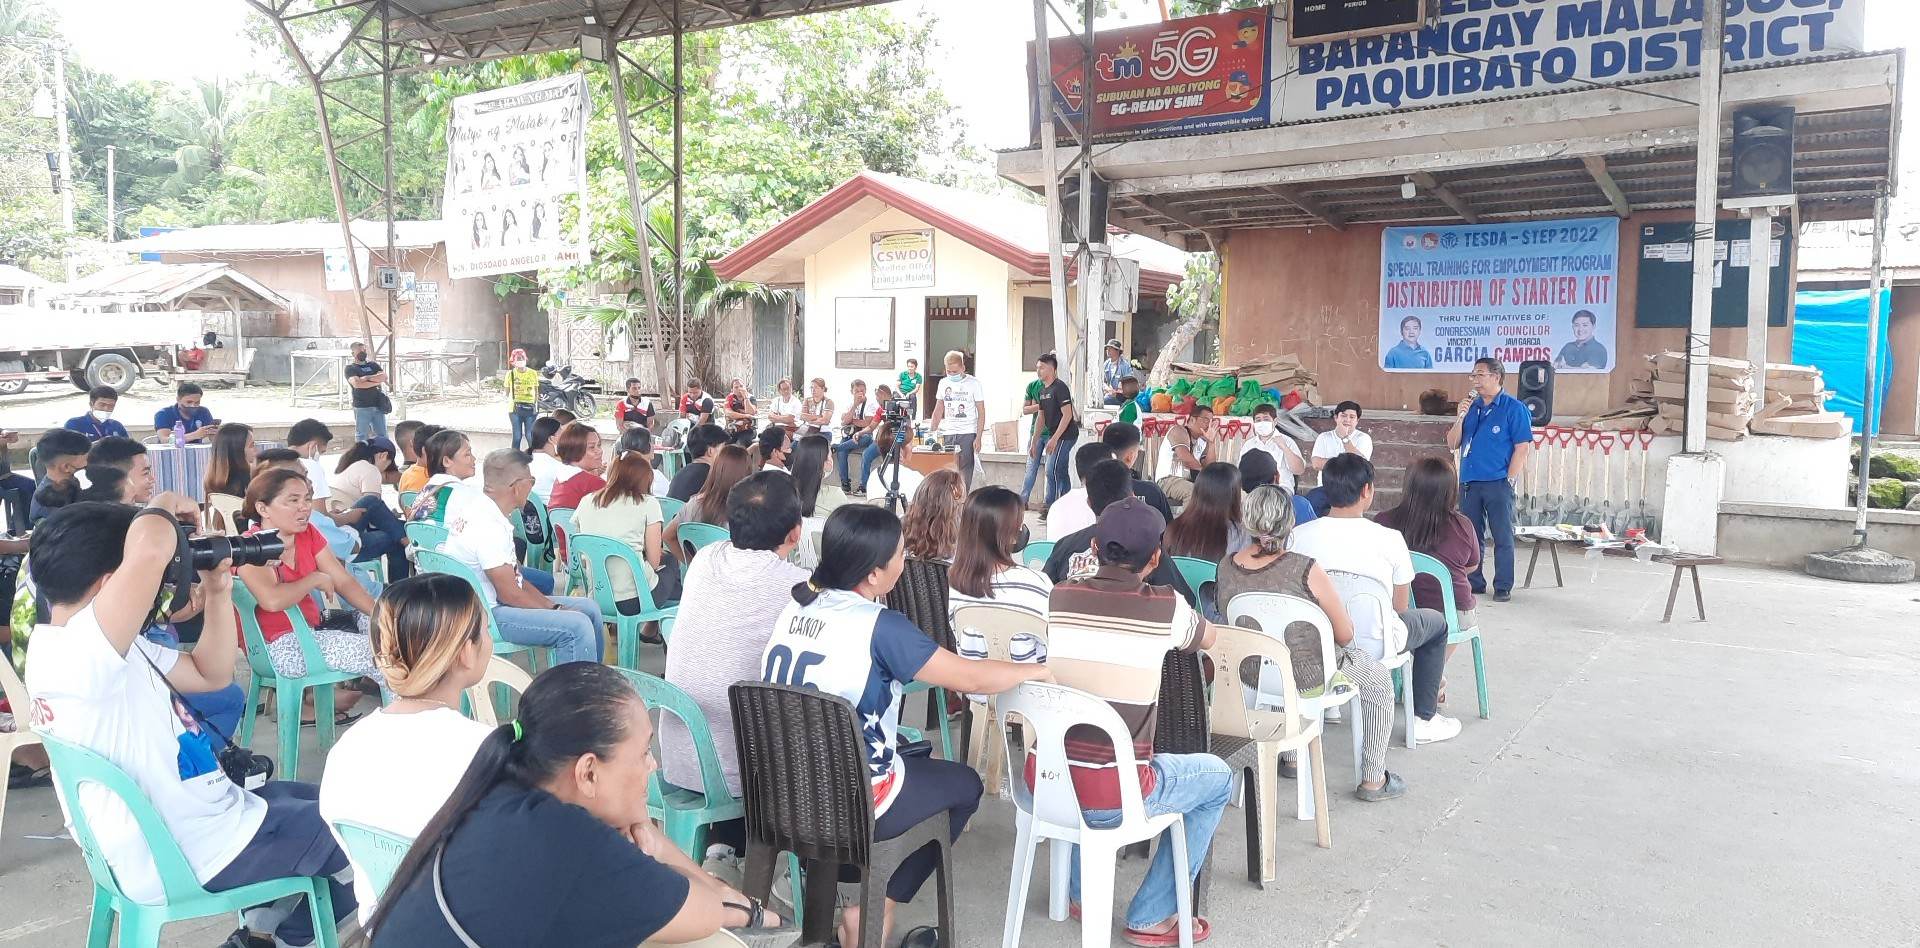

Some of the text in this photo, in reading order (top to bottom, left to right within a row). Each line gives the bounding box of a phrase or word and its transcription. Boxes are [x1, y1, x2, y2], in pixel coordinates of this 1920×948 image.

[1304, 4, 1326, 12] HOME
[1299, 9, 1544, 73] BARANGAY
[1150, 26, 1218, 81] 5G
[1316, 12, 1834, 111] PAQUIBATO DISTRICT
[1096, 80, 1221, 104] SUBUKAN NA ANG IYONG
[1110, 94, 1204, 116] 5G-READY SIM!
[1209, 118, 1240, 128] compatible
[1464, 230, 1507, 247] TESDA
[1522, 229, 1557, 244] STEP
[1559, 226, 1598, 243] 2022
[877, 248, 928, 262] CSWDO
[1387, 254, 1612, 277] SPECIAL TRAINING FOR EMPLOYMENT PROGRAM
[1387, 275, 1610, 308] DISTRIBUTION OF STARTER KIT
[1435, 325, 1550, 337] CONGRESSMAN COUNCILOR
[1447, 338, 1472, 346] VINCENT
[1505, 338, 1518, 346] JAVI
[1519, 337, 1541, 346] GARCIA
[1434, 347, 1551, 363] GARCIA CAMPOS
[788, 615, 827, 640] CANOY
